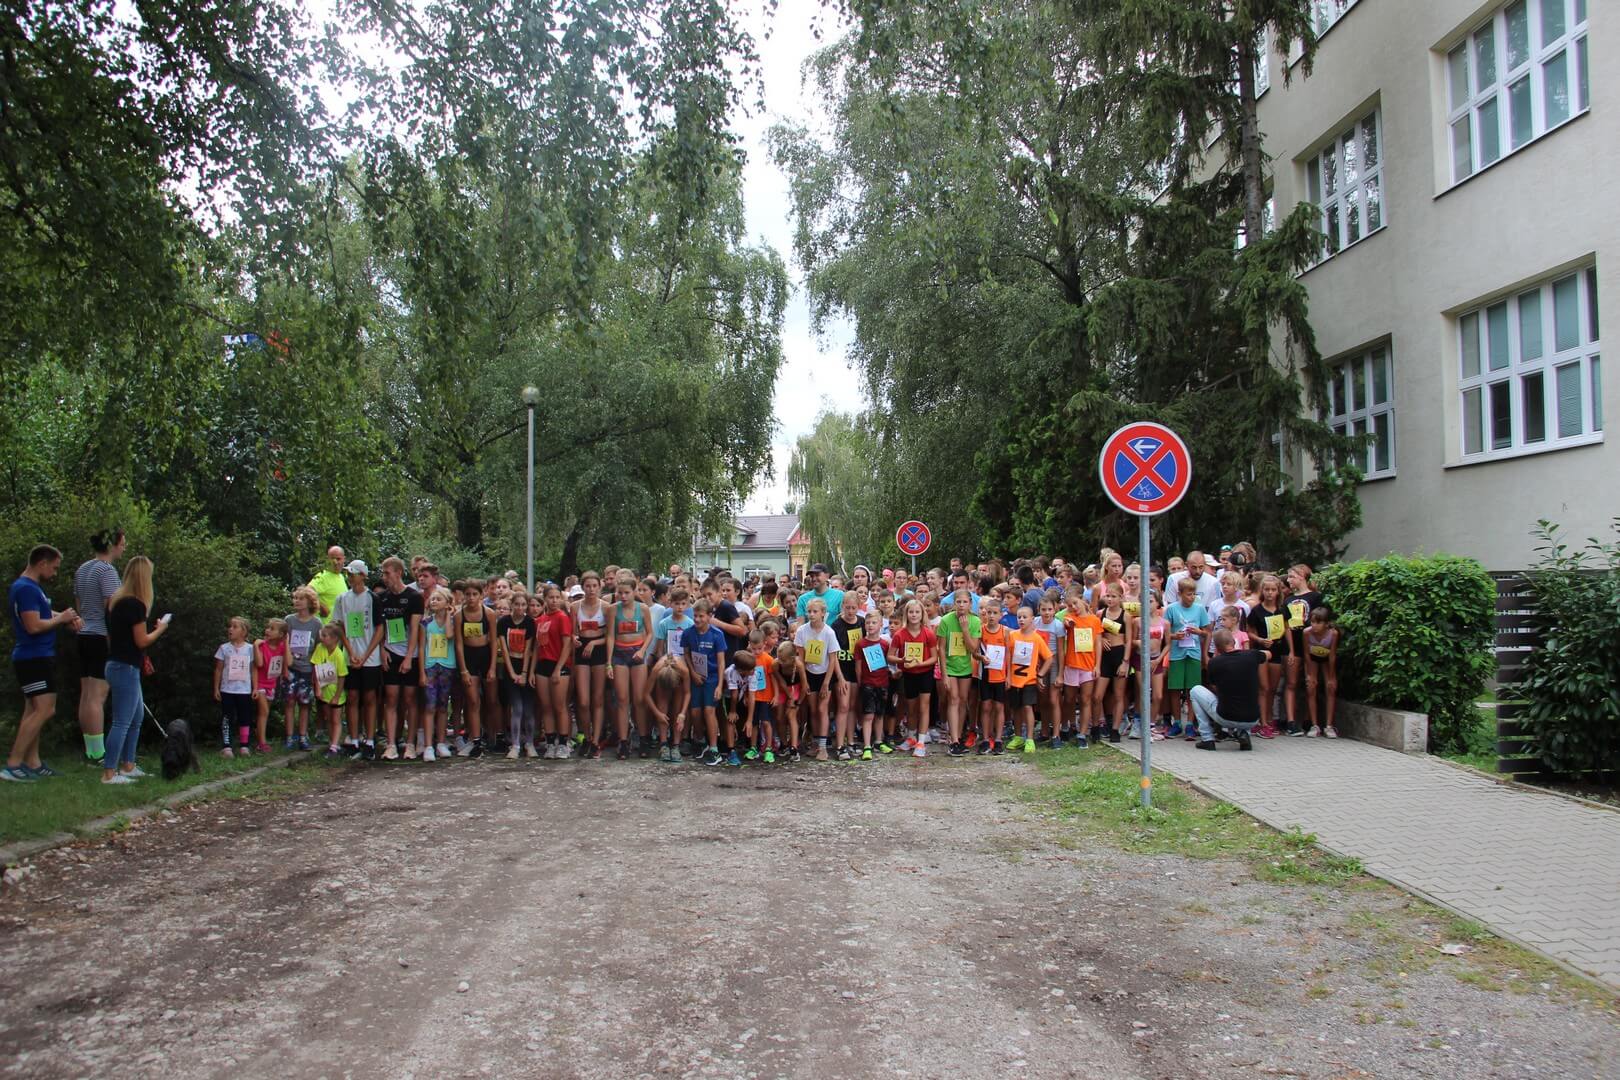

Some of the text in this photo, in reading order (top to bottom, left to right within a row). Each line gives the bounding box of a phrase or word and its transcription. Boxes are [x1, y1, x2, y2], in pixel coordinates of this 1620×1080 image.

[434, 638, 446, 649] 15
[809, 643, 821, 655] 16
[869, 649, 882, 661] 18
[908, 646, 921, 657] 22
[995, 650, 1000, 659] 7
[1020, 647, 1027, 656] 4
[231, 659, 247, 670] 24
[271, 660, 281, 671] 15
[321, 667, 334, 678] 16
